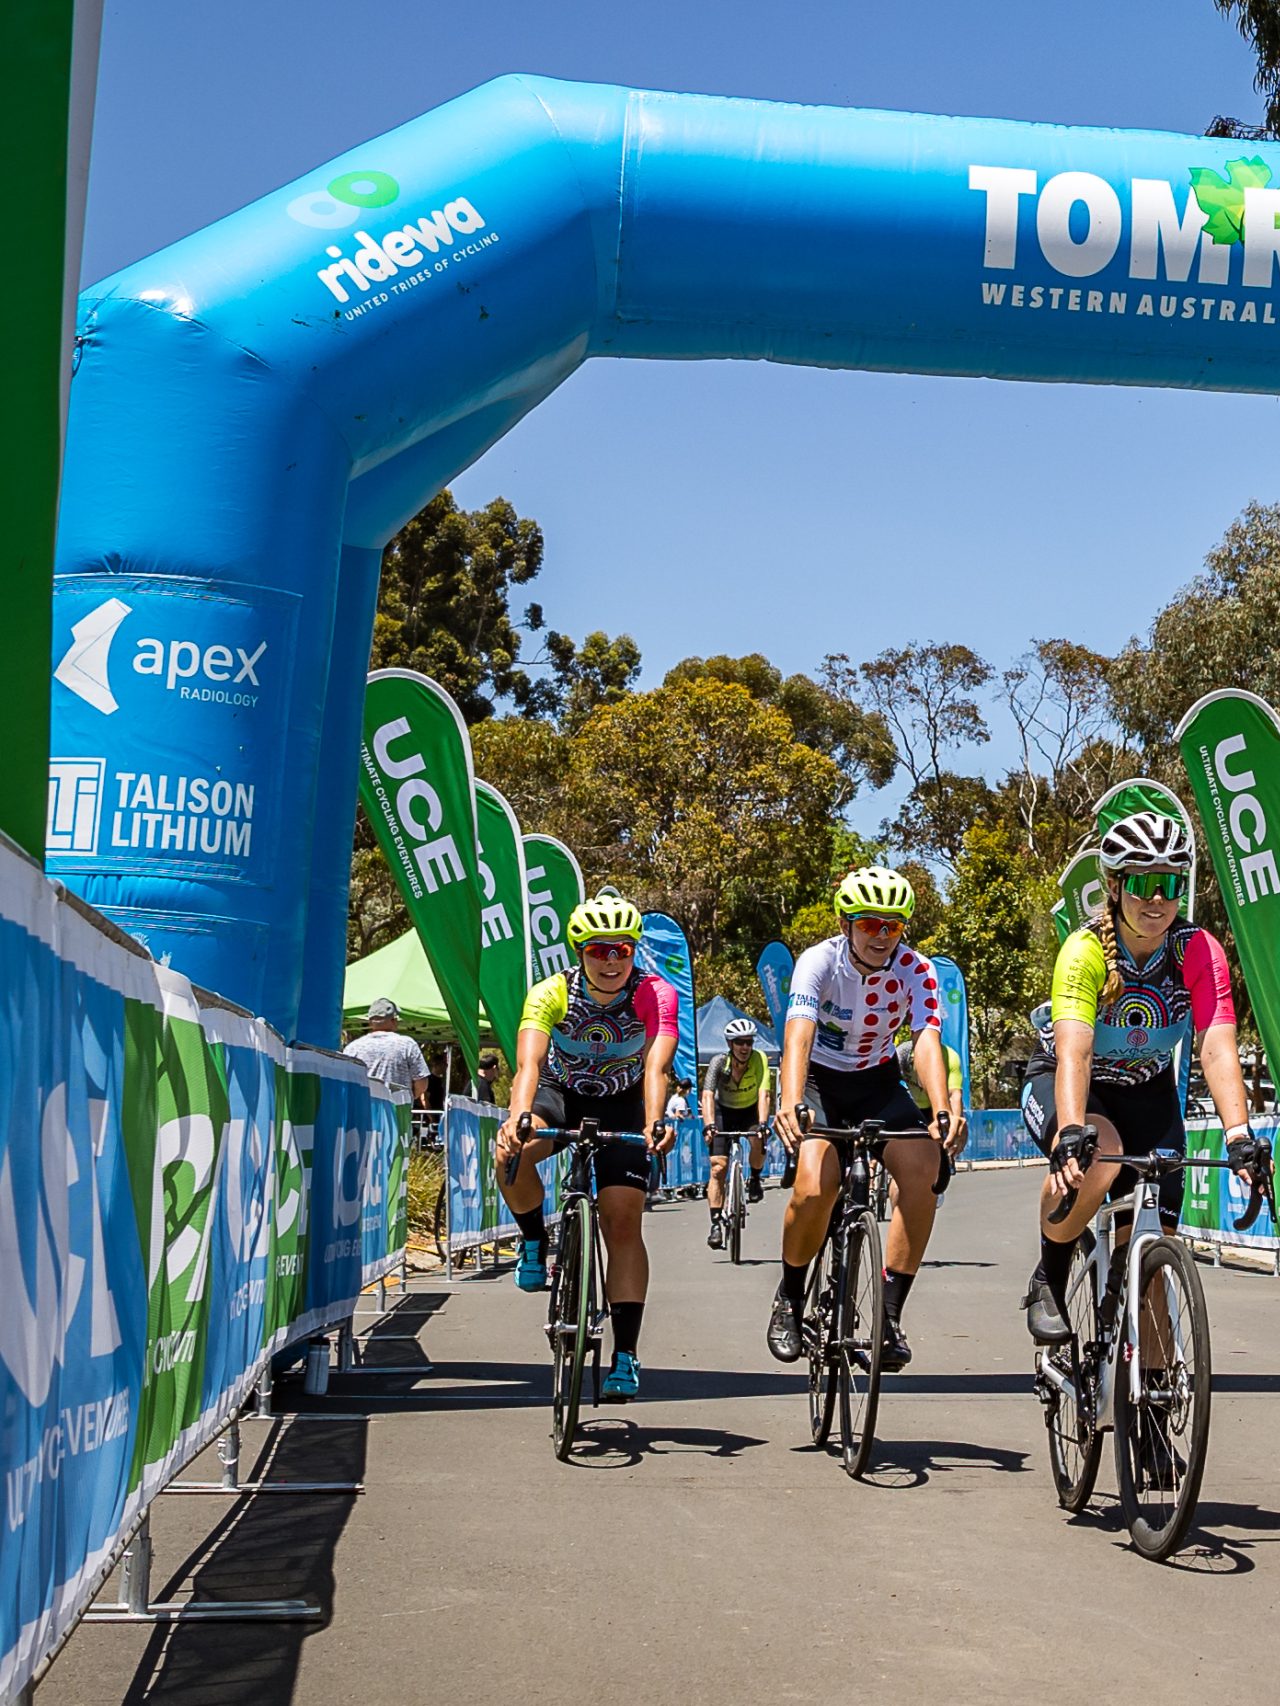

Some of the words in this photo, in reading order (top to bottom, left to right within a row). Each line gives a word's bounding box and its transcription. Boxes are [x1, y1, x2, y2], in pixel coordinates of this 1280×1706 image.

[317, 197, 486, 303] ridewa
[344, 293, 389, 321] UNITED
[390, 269, 432, 296] TRIBES
[434, 259, 449, 273] OF
[453, 232, 500, 262] CYCLING
[981, 283, 1126, 314] WESTERN
[132, 637, 268, 690] apex
[180, 686, 259, 708] RADIOLOGY
[114, 772, 255, 818] TALISON
[373, 716, 467, 894] UCE
[1200, 745, 1219, 797] ULTIMATE
[1213, 796, 1230, 844] CYCLING
[1225, 845, 1246, 907] EVENTURES
[111, 811, 252, 857] LITHIUM
[375, 786, 400, 838] CYCLING
[394, 836, 423, 899] EVENTURES
